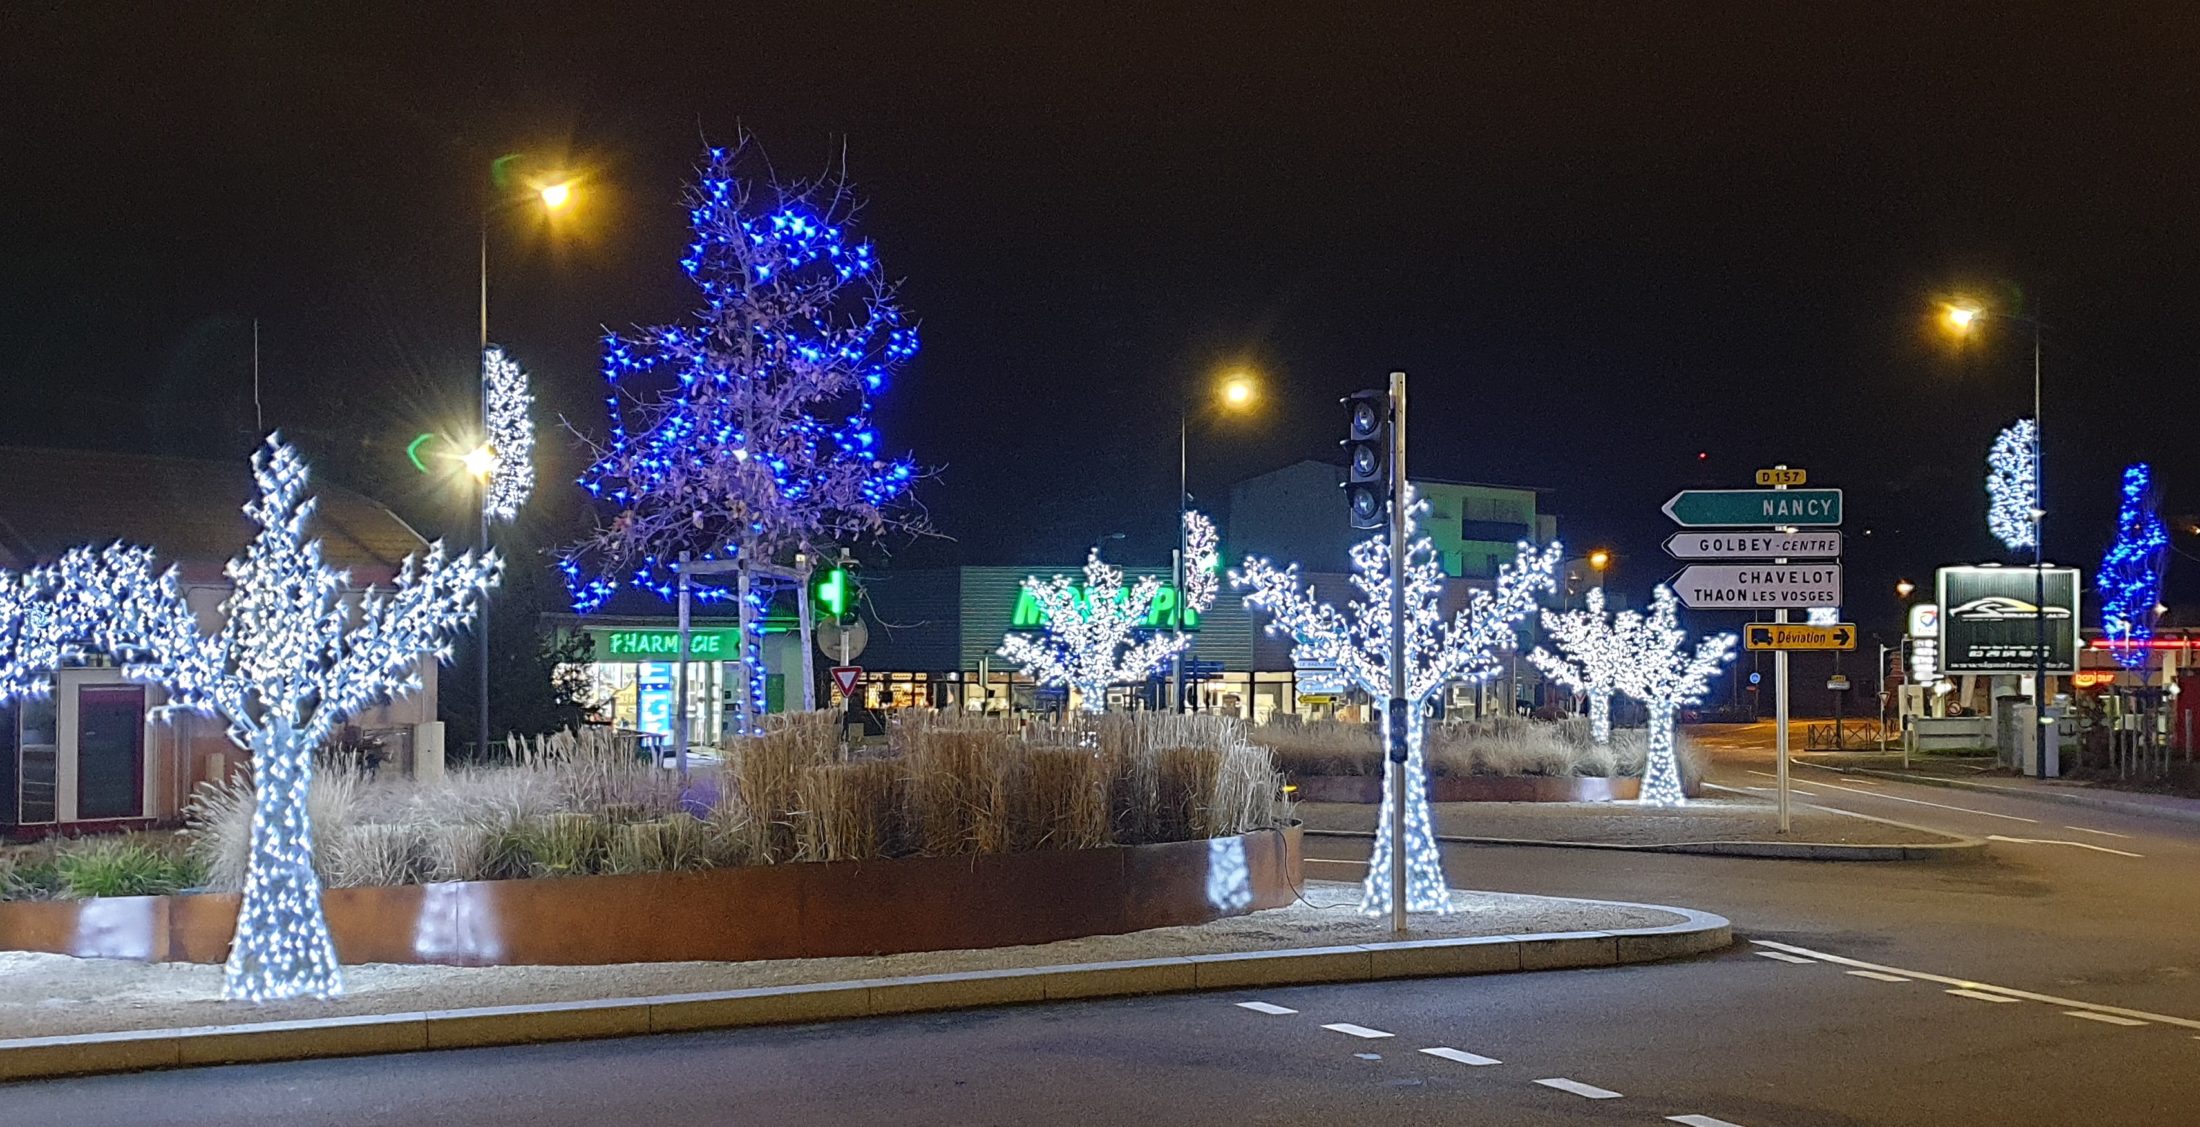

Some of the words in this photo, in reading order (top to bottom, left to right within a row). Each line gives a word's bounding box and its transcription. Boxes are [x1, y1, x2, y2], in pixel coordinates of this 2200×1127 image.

[1762, 472, 1770, 482] D
[1775, 472, 1800, 482] 157
[1762, 499, 1832, 516] NANCY
[1738, 571, 1834, 584] CHAVELOT
[1694, 589, 1747, 601] THAON
[1752, 591, 1776, 601] LES
[1781, 591, 1834, 601] VOSGES
[609, 633, 720, 653] PHARMCIE
[1777, 631, 1826, 644] Déviation
